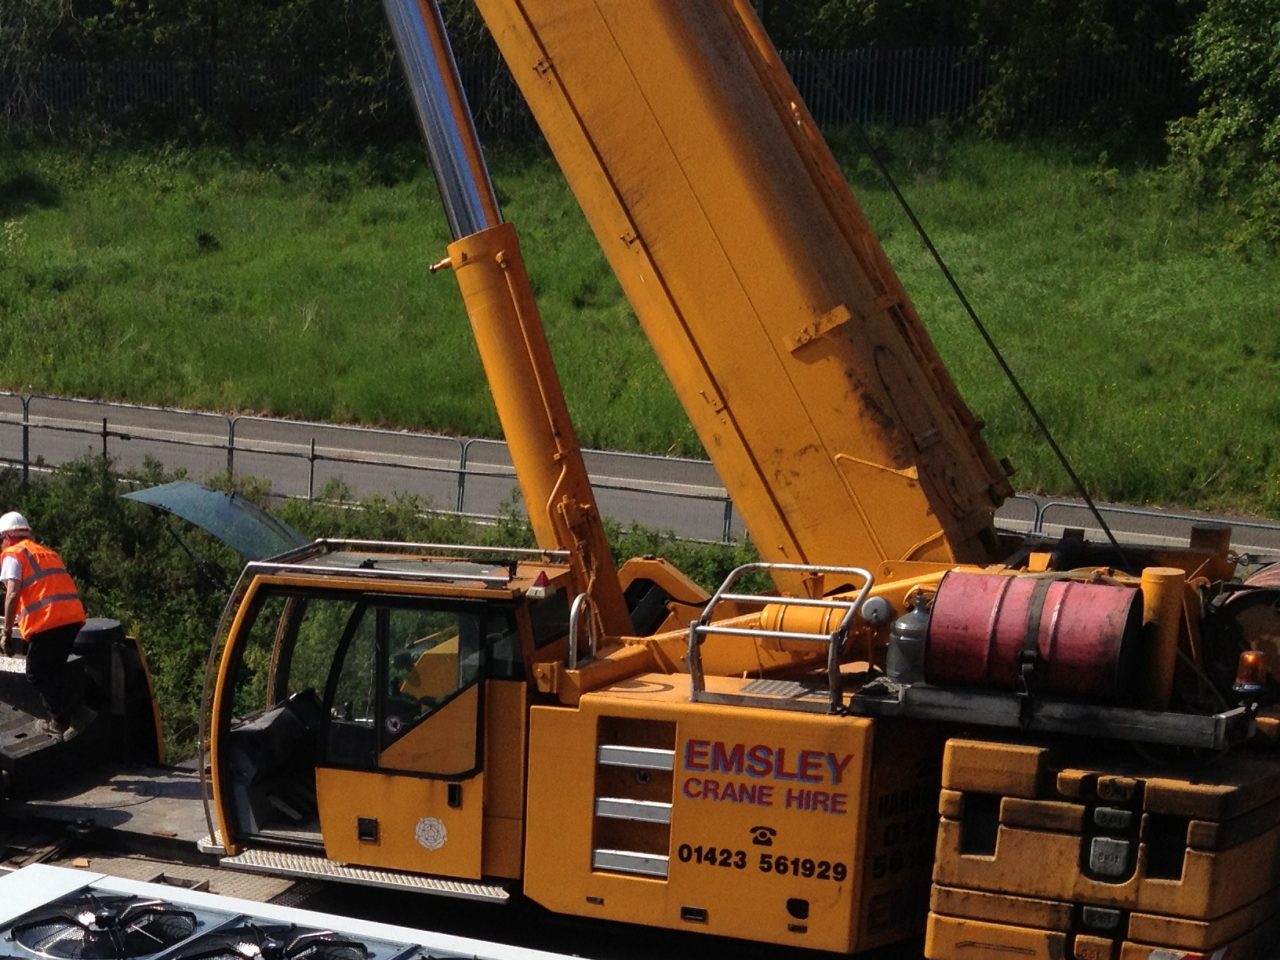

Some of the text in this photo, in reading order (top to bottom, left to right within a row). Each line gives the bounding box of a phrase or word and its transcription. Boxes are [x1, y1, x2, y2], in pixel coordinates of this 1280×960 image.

[684, 739, 855, 785] EMSLEY
[682, 777, 774, 807] CRANE
[785, 788, 847, 815] HIRE
[678, 844, 747, 869] 01423
[759, 854, 847, 882] 561929
